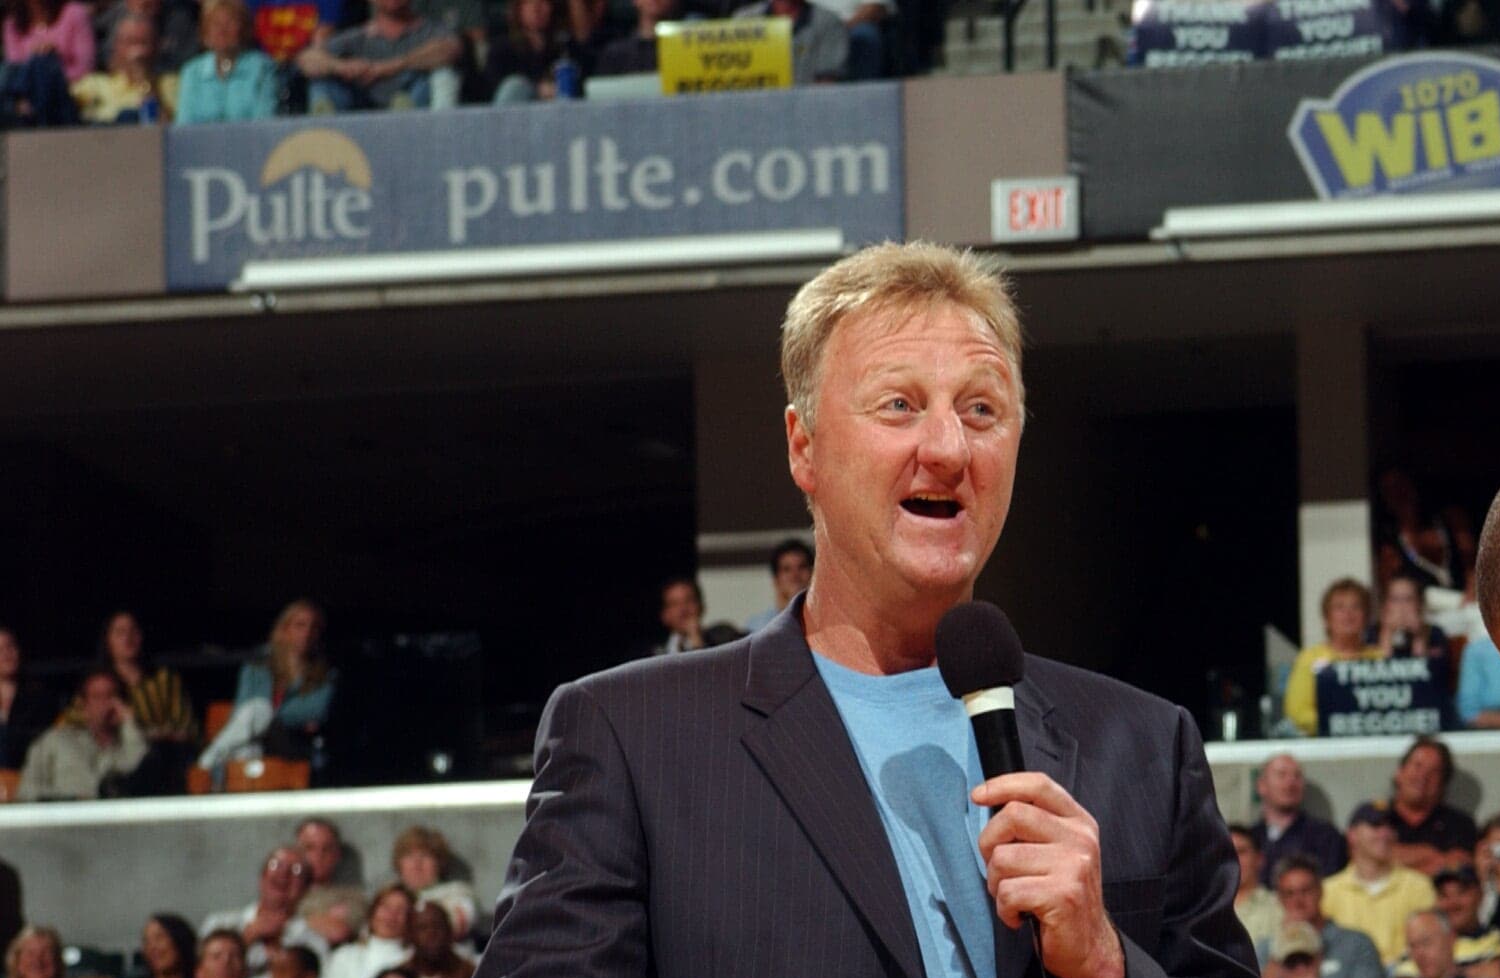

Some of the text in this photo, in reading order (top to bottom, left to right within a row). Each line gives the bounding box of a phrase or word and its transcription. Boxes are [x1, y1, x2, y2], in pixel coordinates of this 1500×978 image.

[1173, 26, 1229, 49] YOU
[1297, 14, 1354, 41] YOU
[702, 52, 753, 70] YOU
[1402, 70, 1479, 110] 1070
[443, 136, 889, 243] pulte.com
[181, 165, 373, 263] Pulte
[1008, 186, 1065, 231] EXIT
[1334, 658, 1431, 685] THANK
[1354, 684, 1412, 709] YOU
[1329, 709, 1440, 736] REGGIE!
